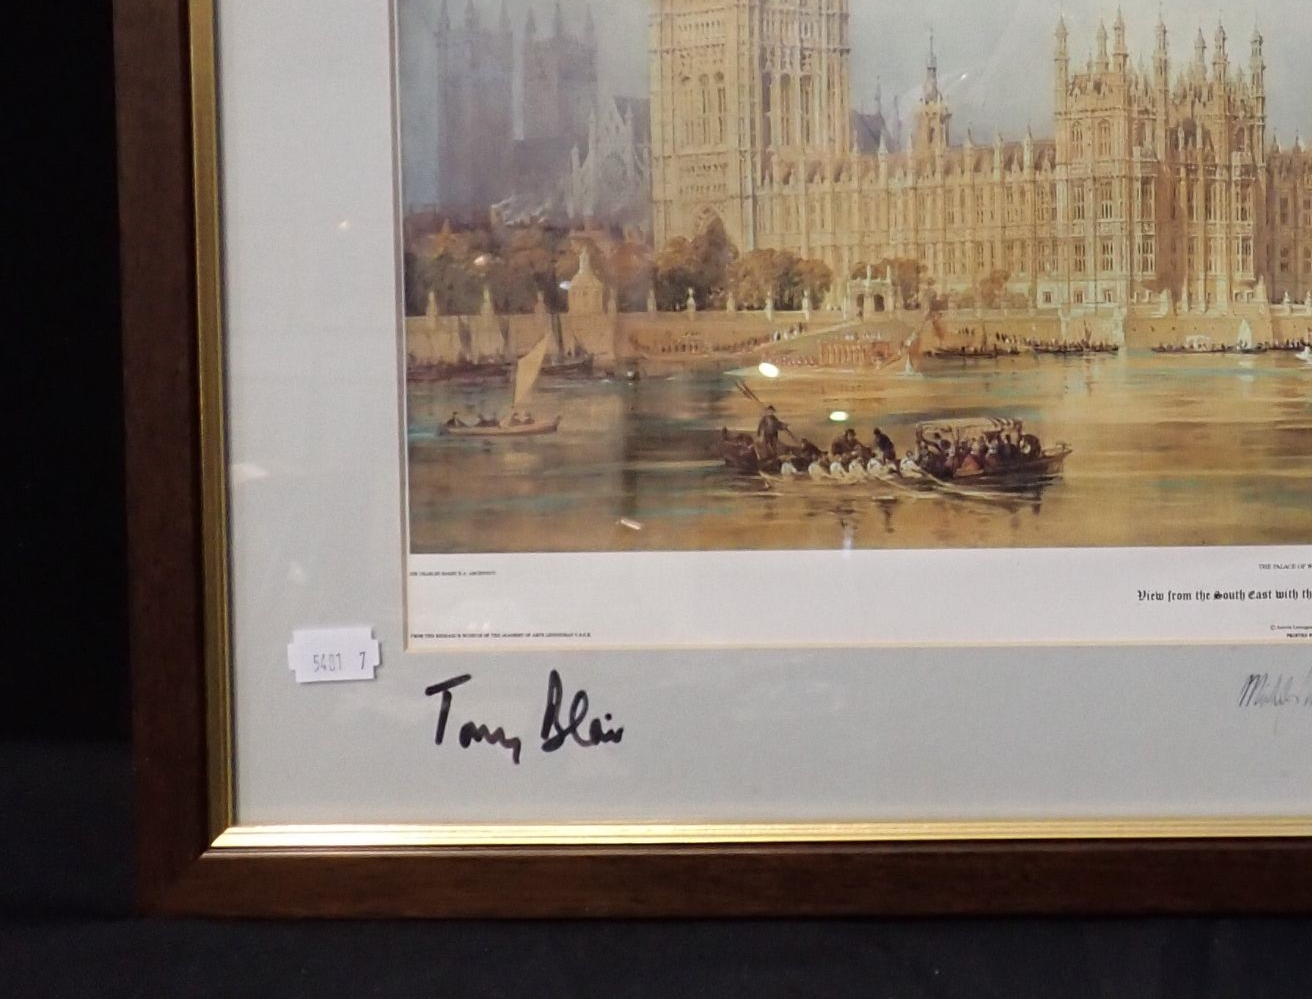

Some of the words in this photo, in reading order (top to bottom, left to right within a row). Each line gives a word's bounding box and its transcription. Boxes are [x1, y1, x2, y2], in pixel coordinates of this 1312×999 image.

[1137, 589, 1165, 602] View
[1168, 589, 1192, 602] from
[1195, 589, 1211, 602] the
[1213, 589, 1246, 602] South
[1248, 589, 1272, 601] East
[1275, 588, 1299, 601] with
[359, 651, 367, 670] 7
[425, 674, 521, 765] Tony
[541, 669, 624, 752] Blair
